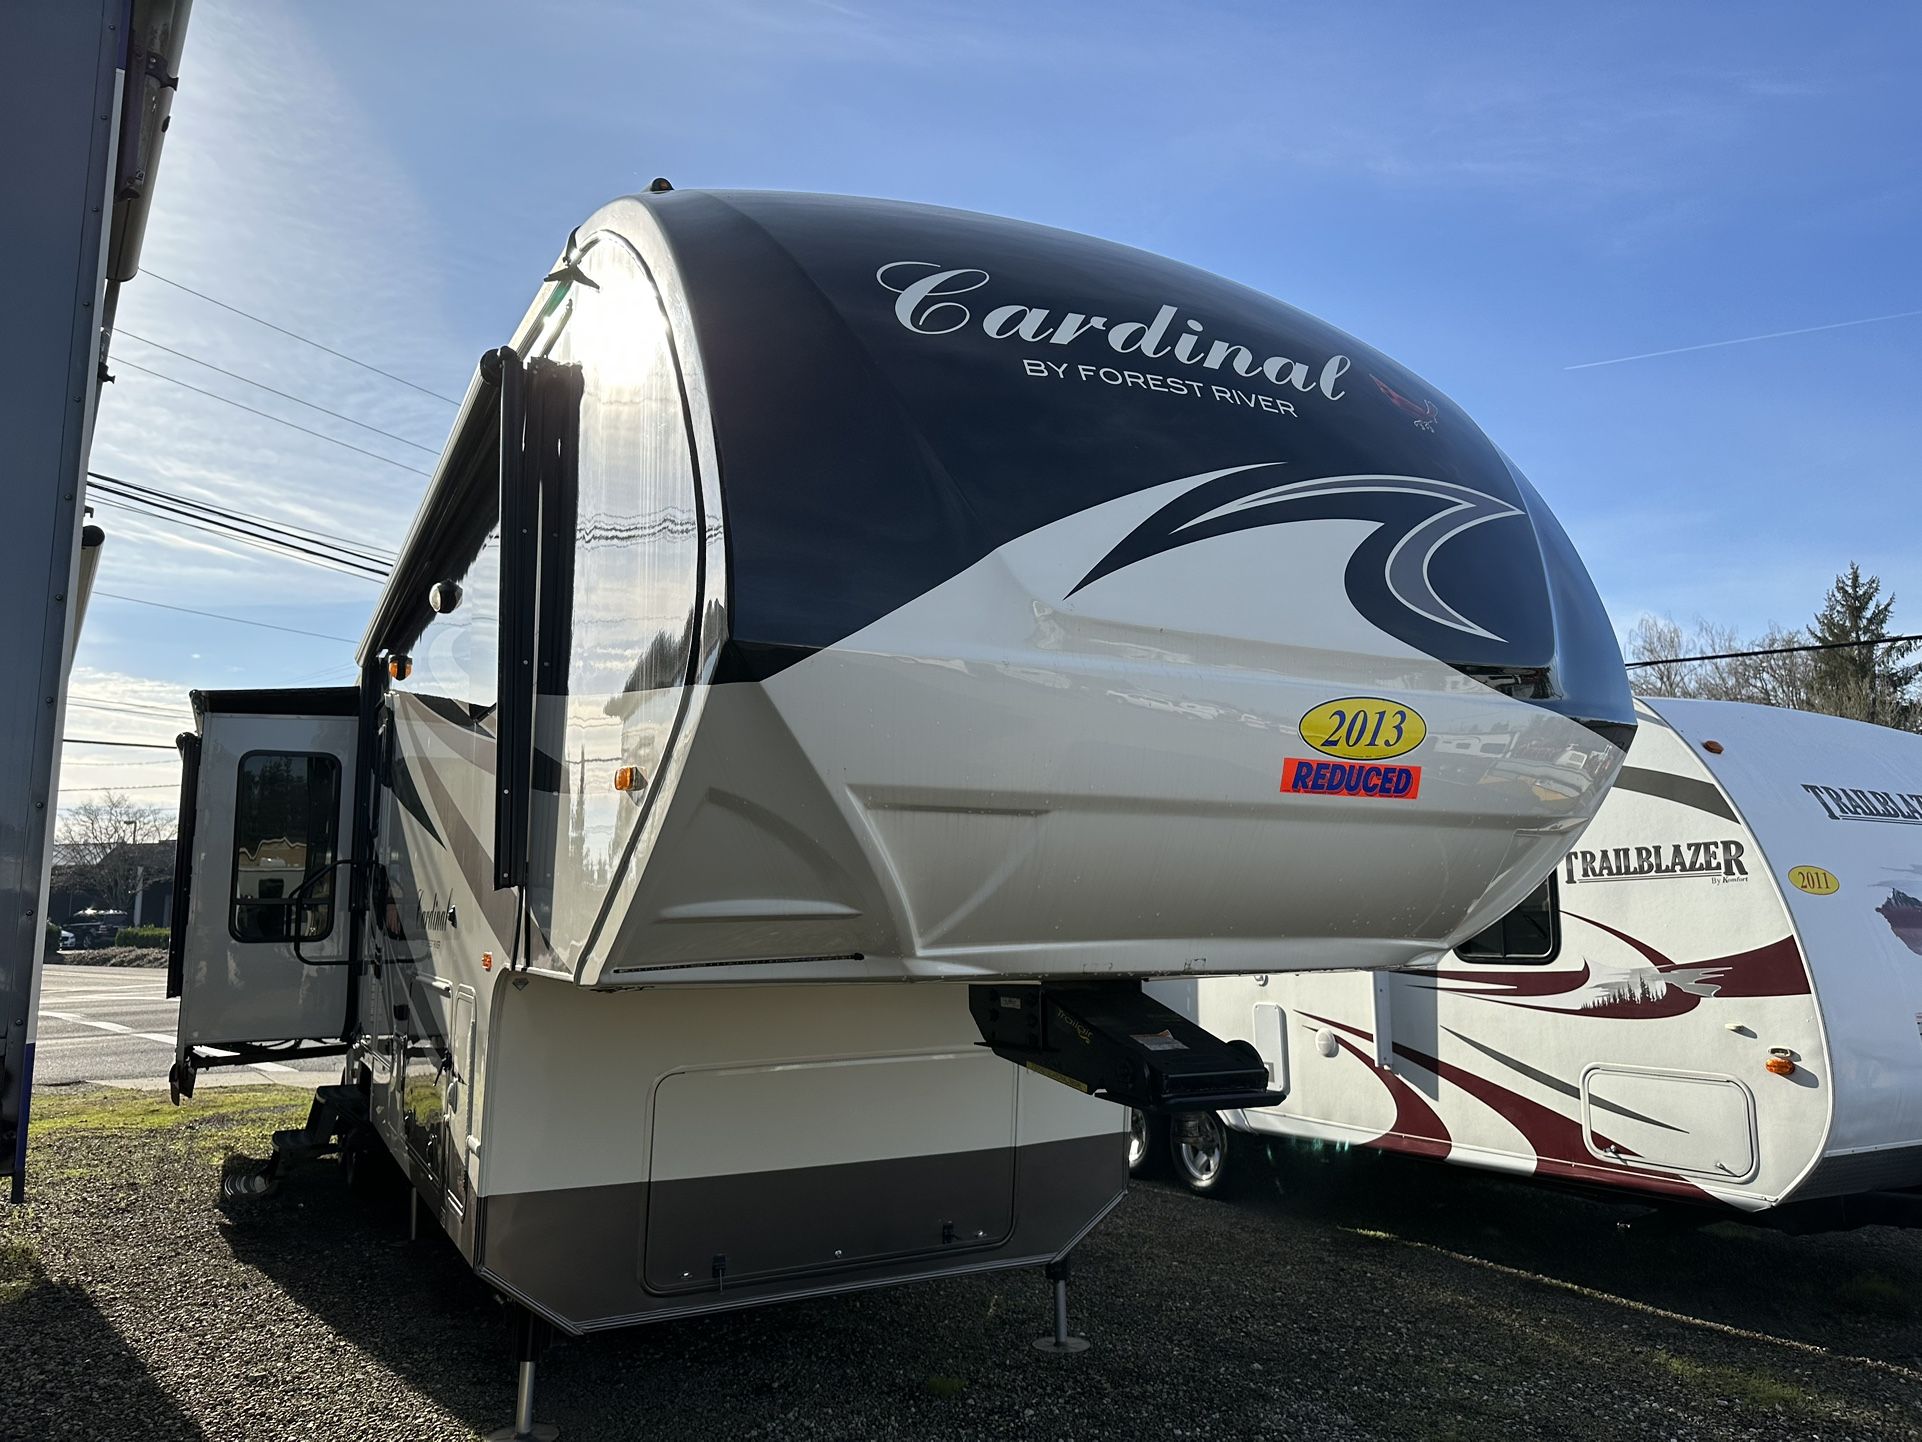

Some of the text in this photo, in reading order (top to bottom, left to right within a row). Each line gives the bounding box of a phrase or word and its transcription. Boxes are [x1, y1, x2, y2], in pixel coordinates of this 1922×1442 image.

[876, 261, 1351, 401] Cardinal
[1022, 358, 1298, 418] BY FOREST RIVER
[1320, 709, 1407, 748] 2013
[1292, 760, 1414, 799] REDUCED
[1711, 876, 1749, 886] By Komfort
[1797, 871, 1830, 889] 2011
